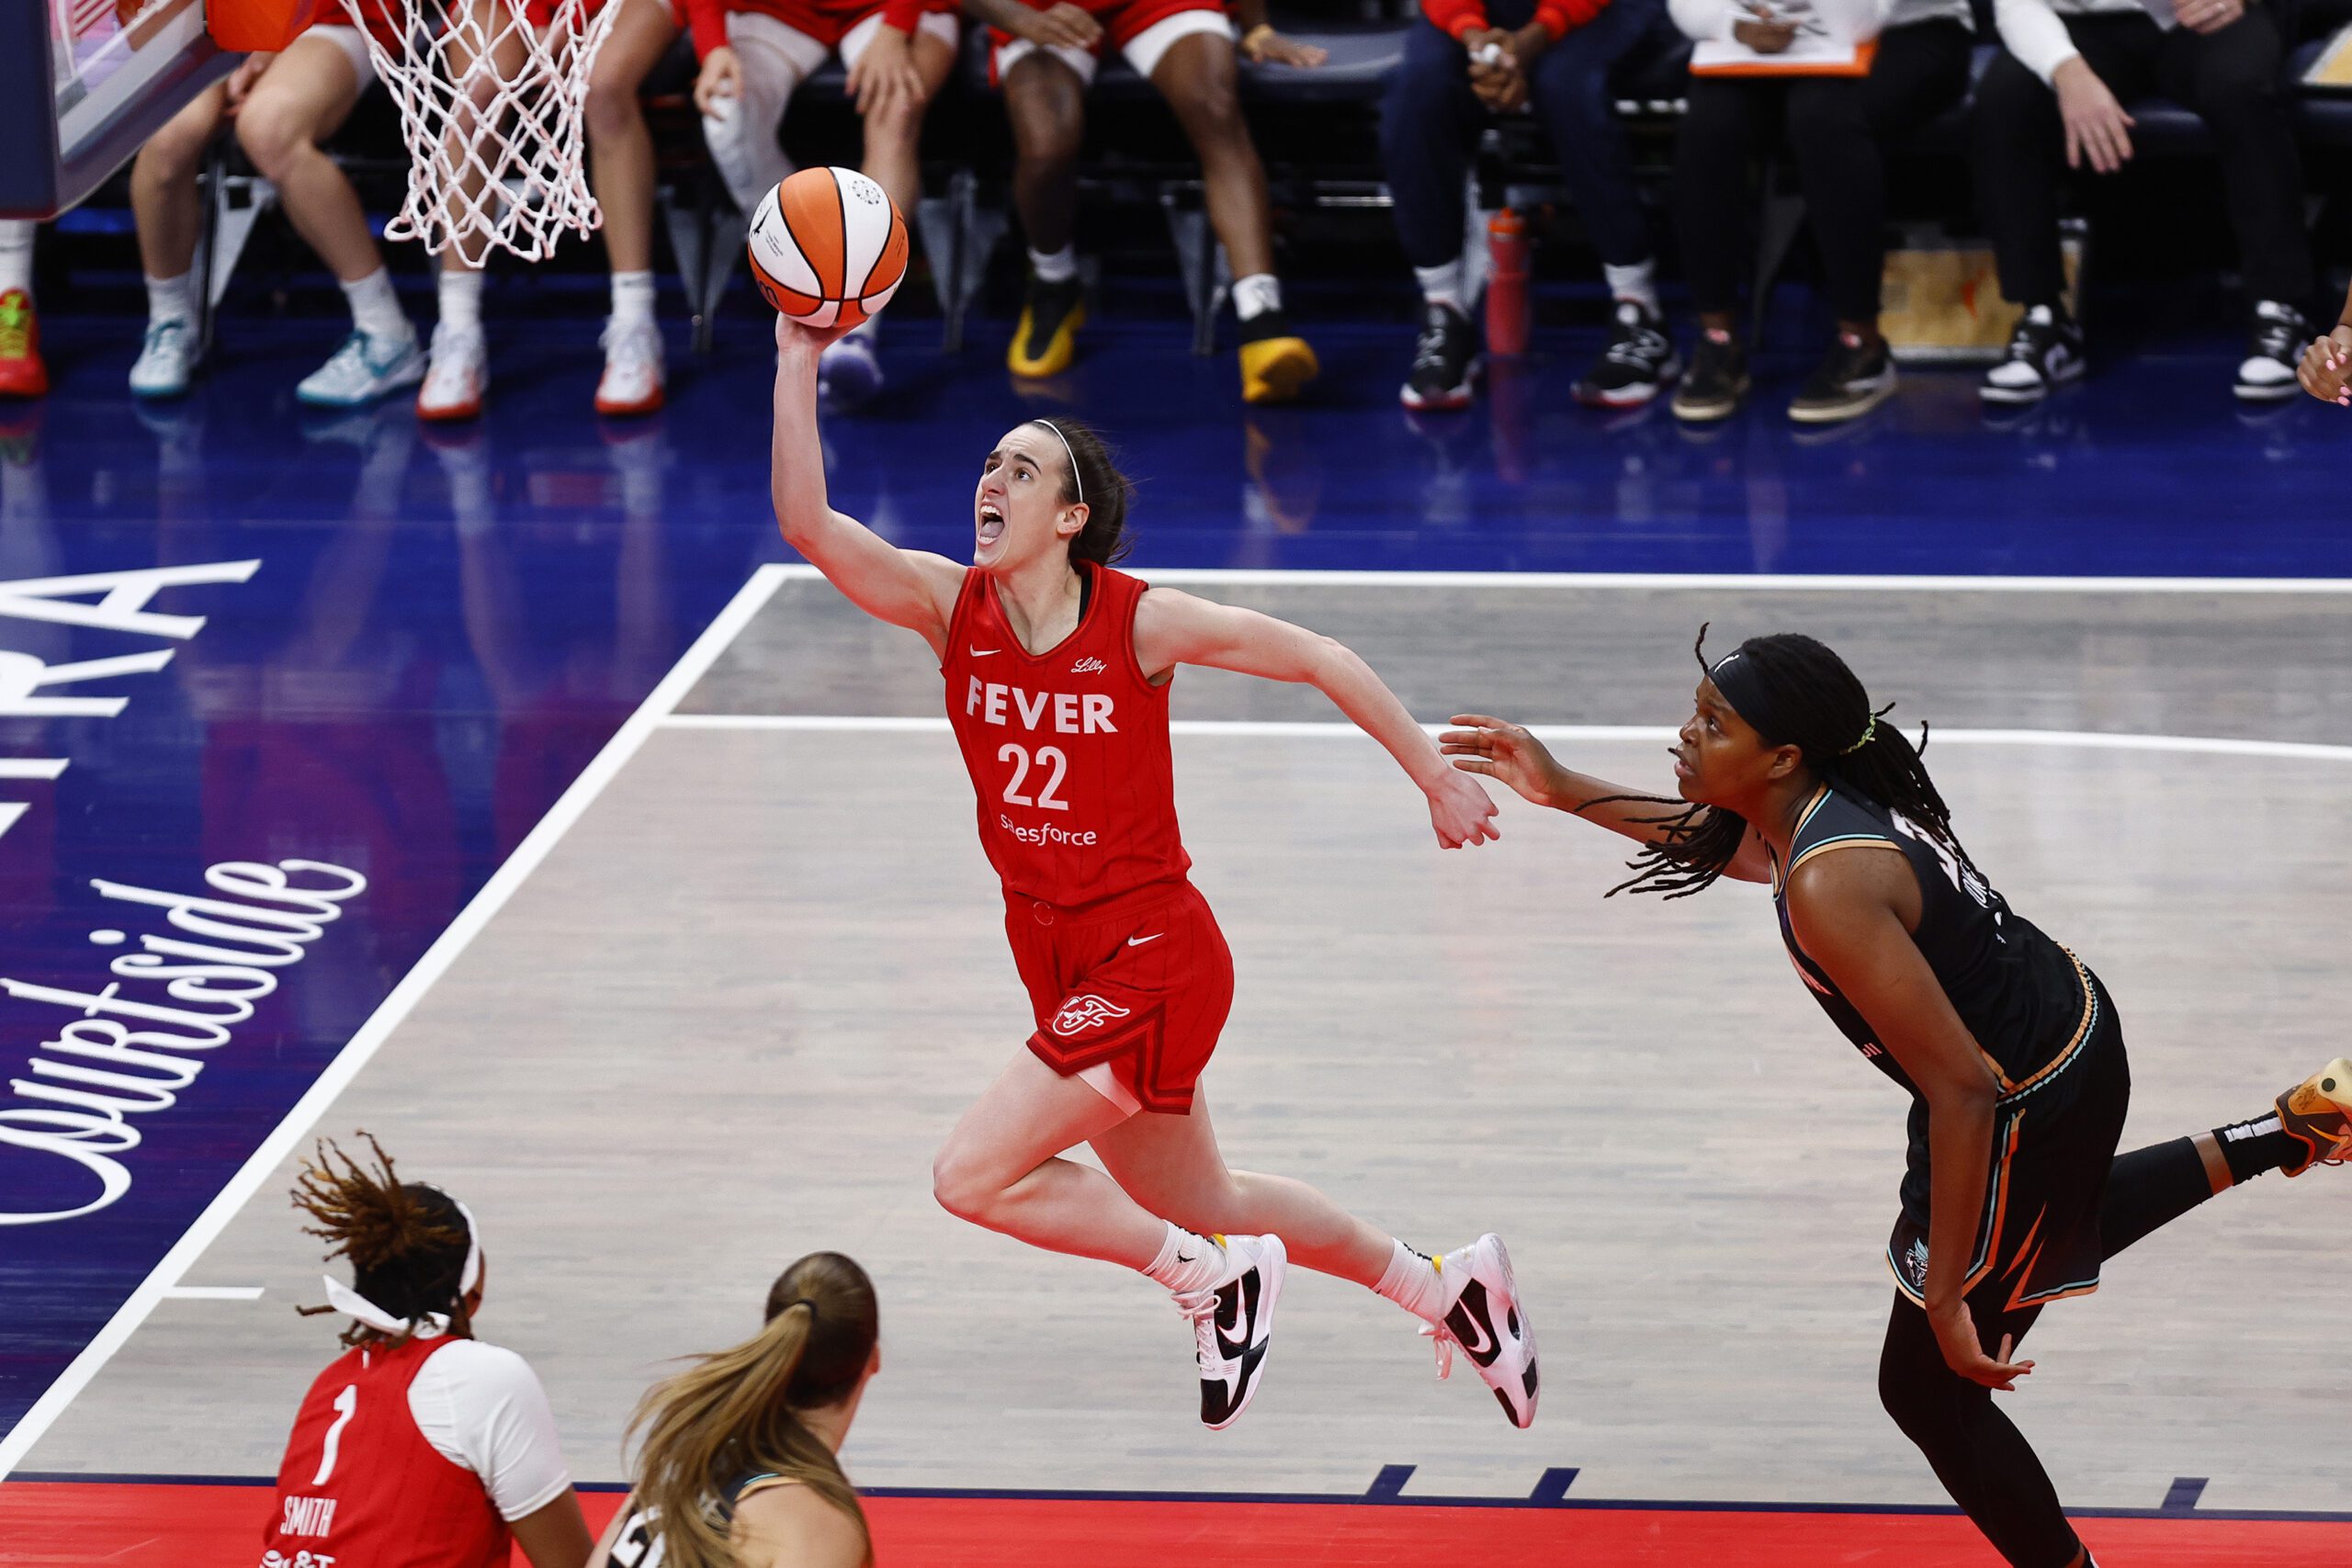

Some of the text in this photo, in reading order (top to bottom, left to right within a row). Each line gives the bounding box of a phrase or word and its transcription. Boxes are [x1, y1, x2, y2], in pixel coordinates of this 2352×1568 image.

[1070, 656, 1108, 675] Lilly
[967, 674, 1118, 734] FEVER
[998, 743, 1069, 811] 22
[1001, 814, 1097, 846] saesforce
[311, 1383, 357, 1486] 1
[279, 1495, 337, 1538] SMITH
